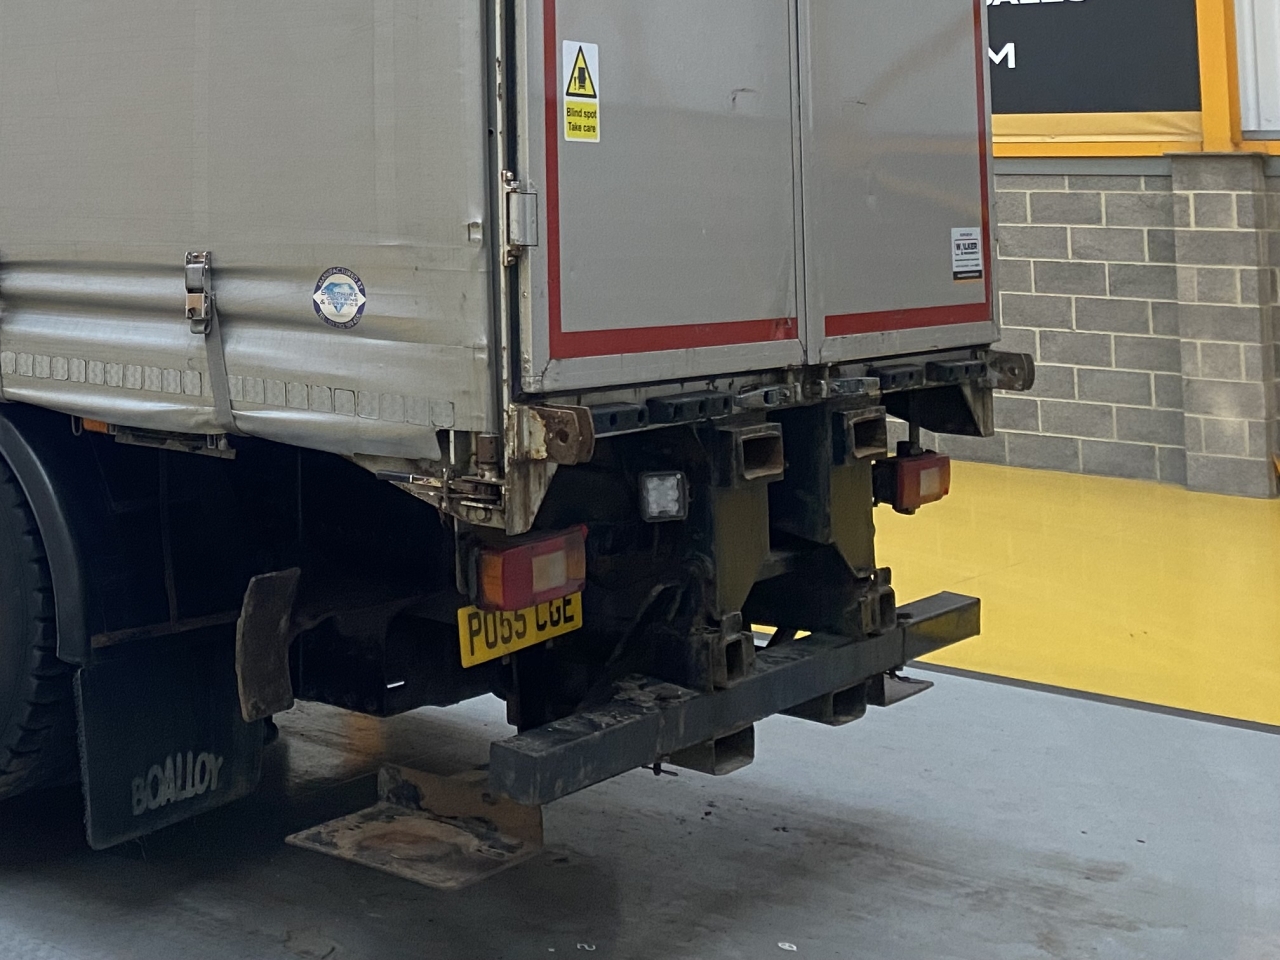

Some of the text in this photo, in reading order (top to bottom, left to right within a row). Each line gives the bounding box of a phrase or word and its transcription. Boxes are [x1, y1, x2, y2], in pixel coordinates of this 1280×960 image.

[567, 107, 597, 120] Blind spot
[568, 122, 596, 133] Take care
[131, 750, 224, 816] BOALLOY
